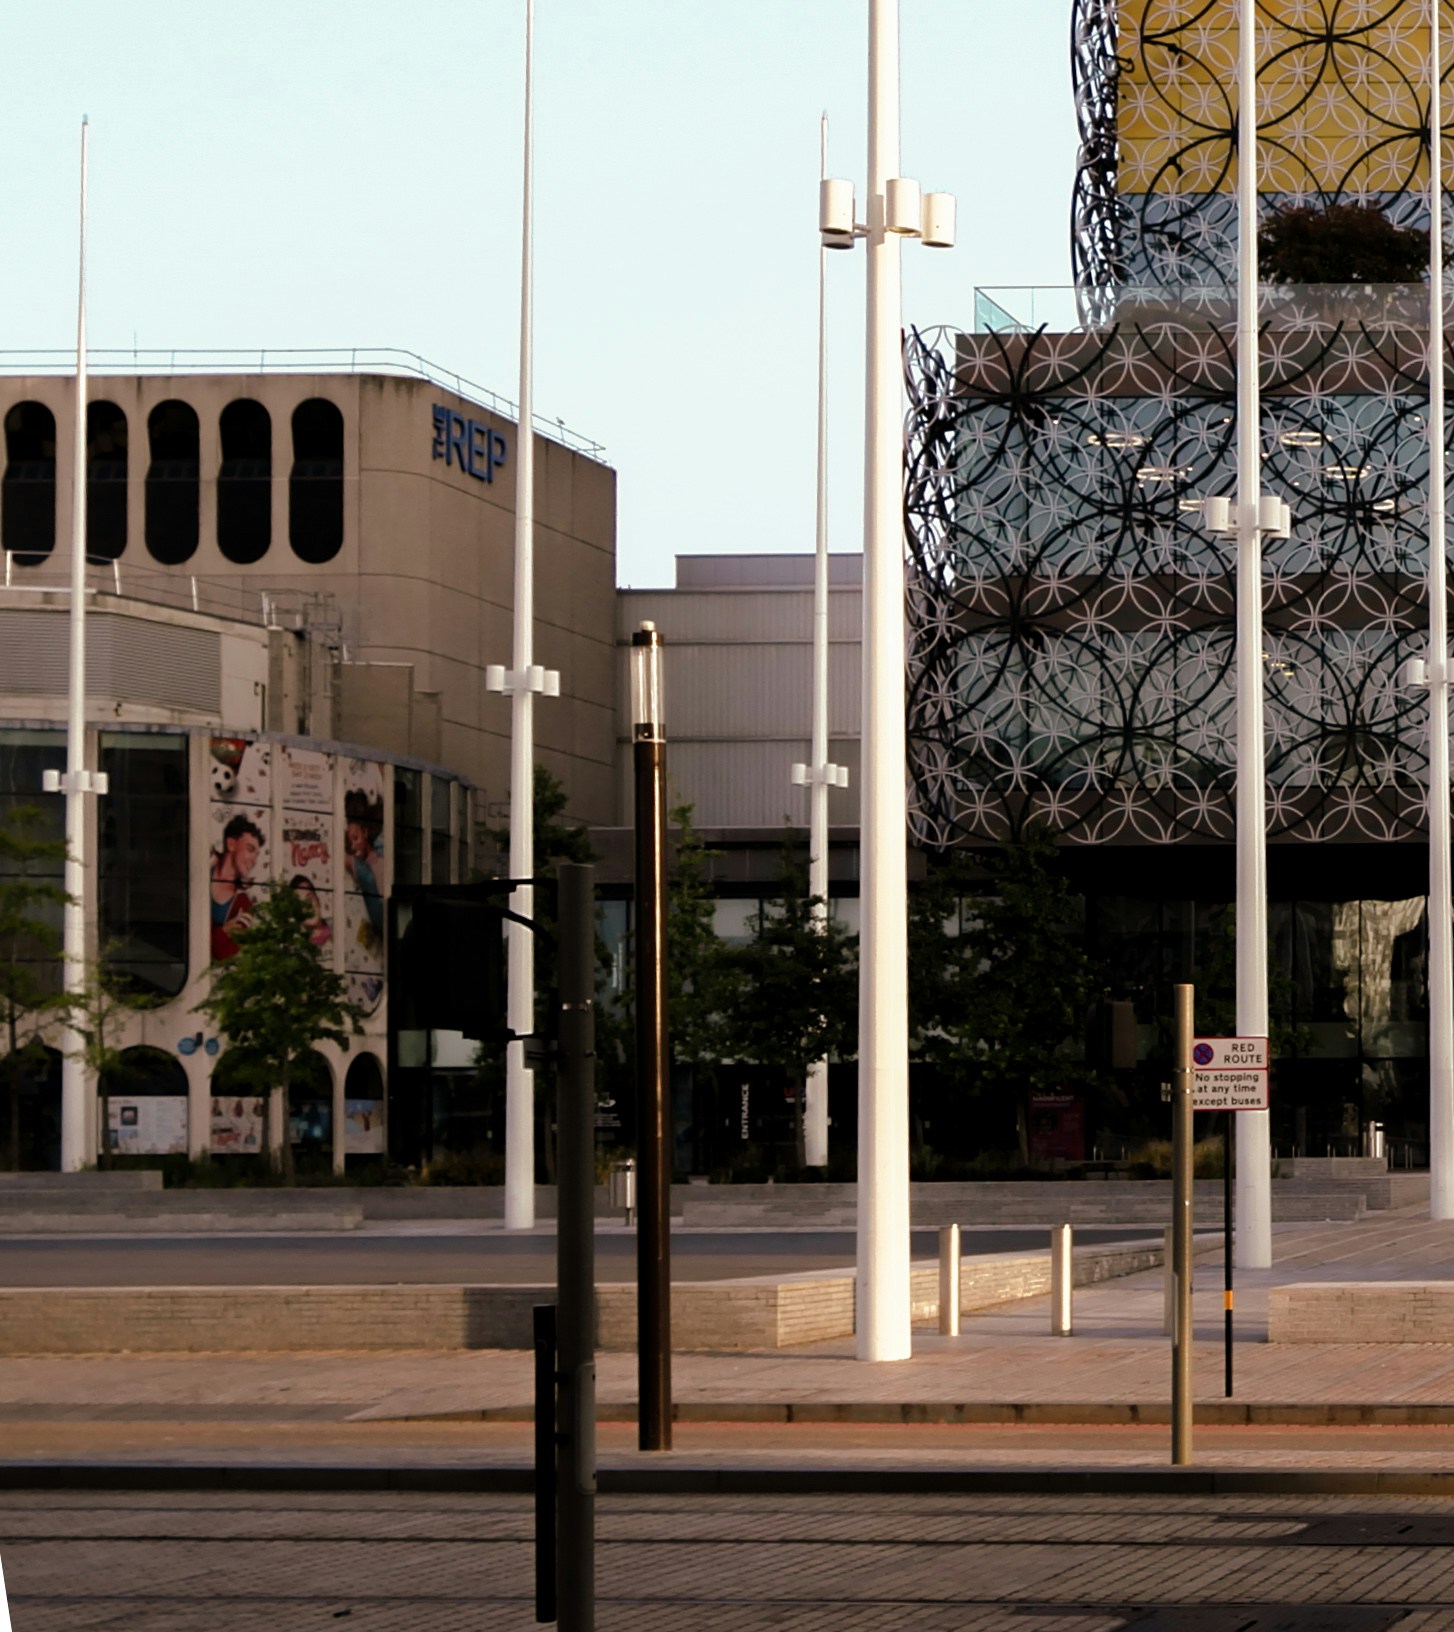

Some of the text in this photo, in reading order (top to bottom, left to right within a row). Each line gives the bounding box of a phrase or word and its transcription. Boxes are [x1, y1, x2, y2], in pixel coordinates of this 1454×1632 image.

[432, 403, 508, 484] THE REP
[1231, 1043, 1255, 1053] RED
[1223, 1054, 1263, 1064] ROUTE
[1195, 1072, 1259, 1083] No stopping
[1197, 1084, 1256, 1094] at any time
[1192, 1096, 1262, 1106] except buses
[740, 1083, 750, 1140] ENTRANCE
